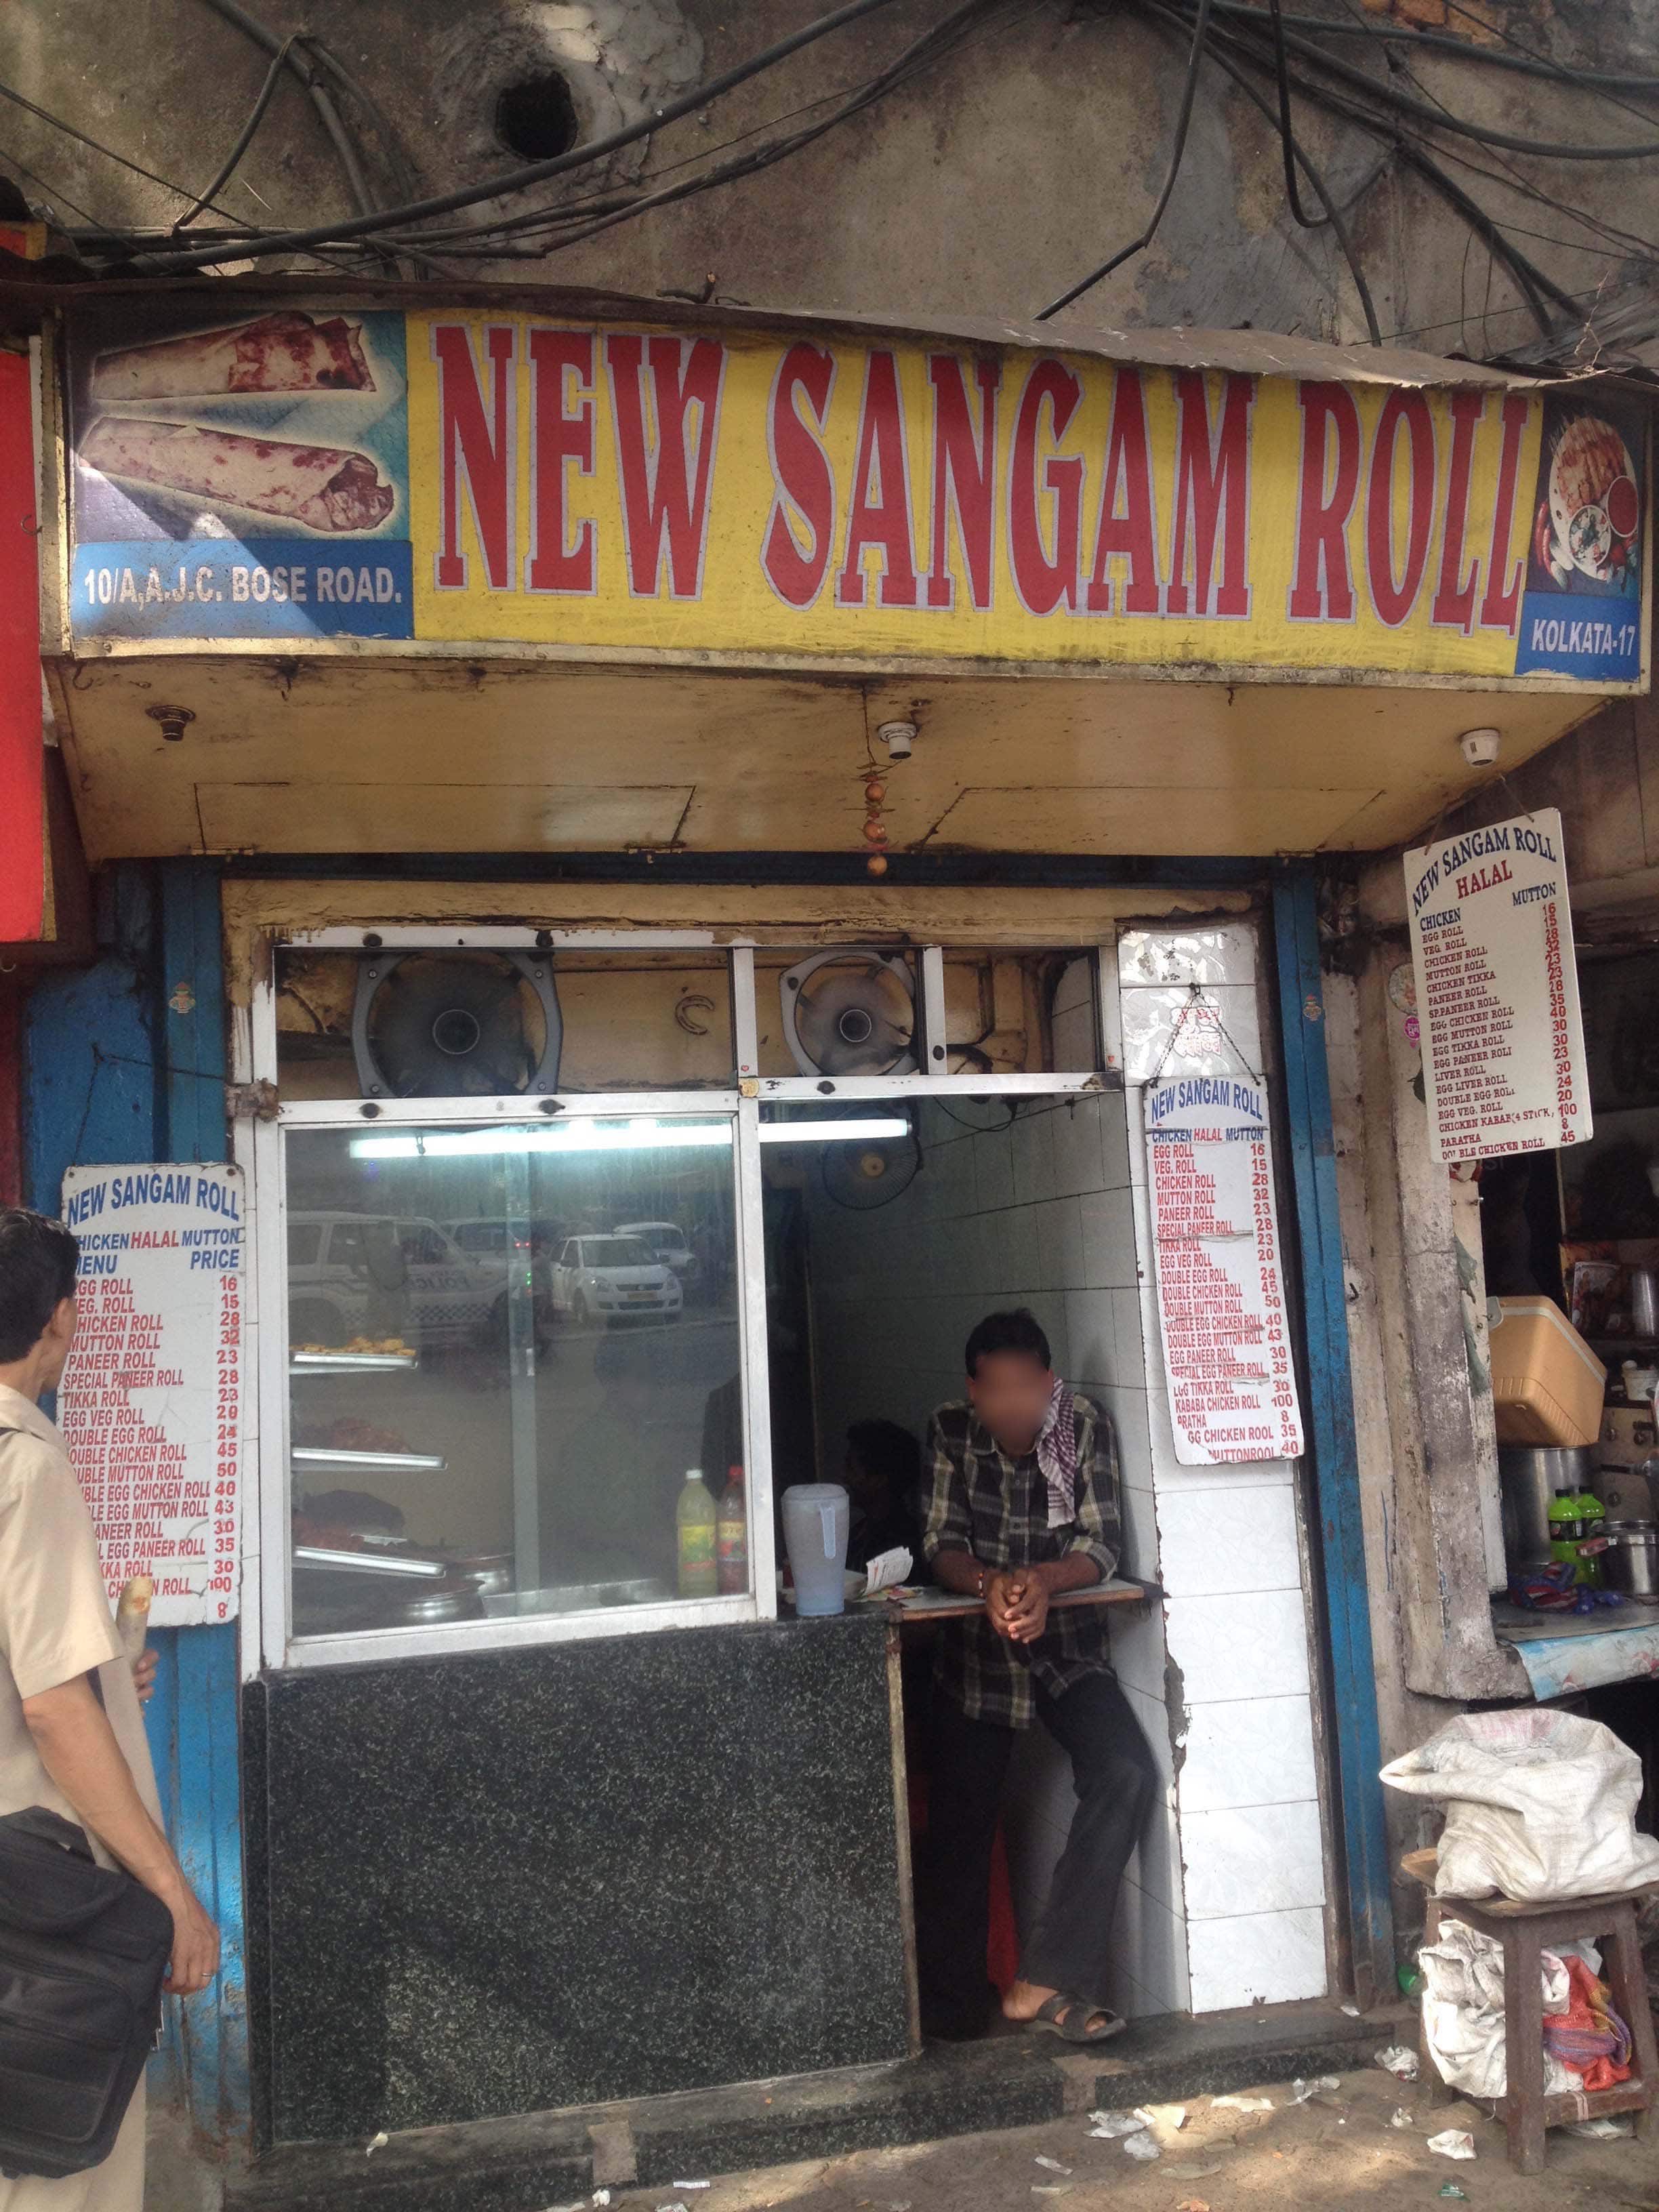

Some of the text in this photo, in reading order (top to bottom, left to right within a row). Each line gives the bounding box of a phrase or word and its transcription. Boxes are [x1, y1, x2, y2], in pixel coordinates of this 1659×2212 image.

[428, 322, 1526, 639] NEW SANGAM ROLL
[232, 566, 307, 603] BOSE
[316, 567, 402, 603] ROAD.
[1532, 618, 1636, 657] KOLKATA-17
[1412, 827, 1557, 916] NEW SANGAM ROLL
[1456, 860, 1513, 899] HALAL
[1420, 882, 1556, 931] CHICKEN MUTTON
[1422, 903, 1556, 943] EGG ROLL 16
[1446, 916, 1557, 950] ROLL 15
[1425, 928, 1559, 968] CHICKEN ROLL 28
[1428, 967, 1563, 1005] PANEER ROLL 23
[1478, 997, 1500, 1008] ROLL
[1549, 981, 1563, 992] 28
[1432, 1006, 1566, 1044] EGG MUTTON ROLL 40
[1434, 1034, 1568, 1069] EGG PANEER 30
[1436, 1061, 1571, 1094] EGG LIVER ROLL 30
[1152, 1079, 1263, 1123] NEW SANGAM ROLL
[1437, 1077, 1572, 1107] DOUBLE EGG 24
[1152, 1128, 1263, 1143] CHICKEN HALAL MUTTON
[1440, 1134, 1481, 1147] PARATHA
[1478, 1131, 1575, 1155] CHICKEN ROLL 45
[1153, 1144, 1265, 1158] EGG ROLL 16
[1155, 1160, 1267, 1174] VEG. ROLL 15
[1156, 1173, 1268, 1190] CHICKEN ROLL 28
[67, 1173, 239, 1228] NEW SANGAM ROLL
[1158, 1189, 1269, 1206] MUTTON ROLL 32
[130, 1231, 179, 1248] HALAL
[182, 1228, 239, 1246] MUTTON
[1158, 1218, 1273, 1237] SPECIAL ROLL 28
[190, 1249, 239, 1269] PRICE
[1160, 1249, 1273, 1269] EGG VEG ROLL 20
[75, 1275, 237, 1296] GG ROLL 16
[1162, 1268, 1276, 1284] DOUBLE EGG ROLL 24
[1162, 1282, 1277, 1301] DOUBLE CHICKEN ROLL 45
[76, 1294, 239, 1313] EG. ROLL 15
[1164, 1296, 1280, 1317] DOUBLE MUTTON ROLL 50
[77, 1311, 239, 1333] HICKEN ROLL 28
[68, 1330, 240, 1352] MUTTON ROLL 32
[1168, 1330, 1282, 1348] DOUBLE EGG MUTTON ROLL 43
[1170, 1347, 1286, 1364] EGG PANEER ROLL 30
[64, 1369, 239, 1389] SPECIAL PANEER ROLL 28
[64, 1388, 239, 1408] TIKKA ROLL 23
[1175, 1394, 1293, 1413] KABABA CHICKEN ROLL 100
[62, 1405, 237, 1427] EGG VEG ROLL 20
[1282, 1411, 1289, 1422] 8
[111, 1428, 134, 1445] EGG
[138, 1426, 166, 1443] ROLL
[217, 1425, 237, 1439] 24
[1204, 1425, 1296, 1442] CHICKEN ROOL 35
[68, 1442, 237, 1465] OUBLE CHICKEN ROLL 45
[107, 1504, 129, 1521] EGG
[133, 1502, 178, 1519] MUTTON
[182, 1500, 209, 1517] ROLL
[215, 1500, 234, 1515] 43
[95, 1521, 234, 1540] ANEER ROLL 30
[107, 1543, 129, 1559] EGG
[133, 1540, 174, 1557] PANEER
[179, 1539, 205, 1556] ROLL
[215, 1538, 234, 1553] 35
[163, 1578, 191, 1594] ROLL
[218, 1603, 226, 1618] 8
